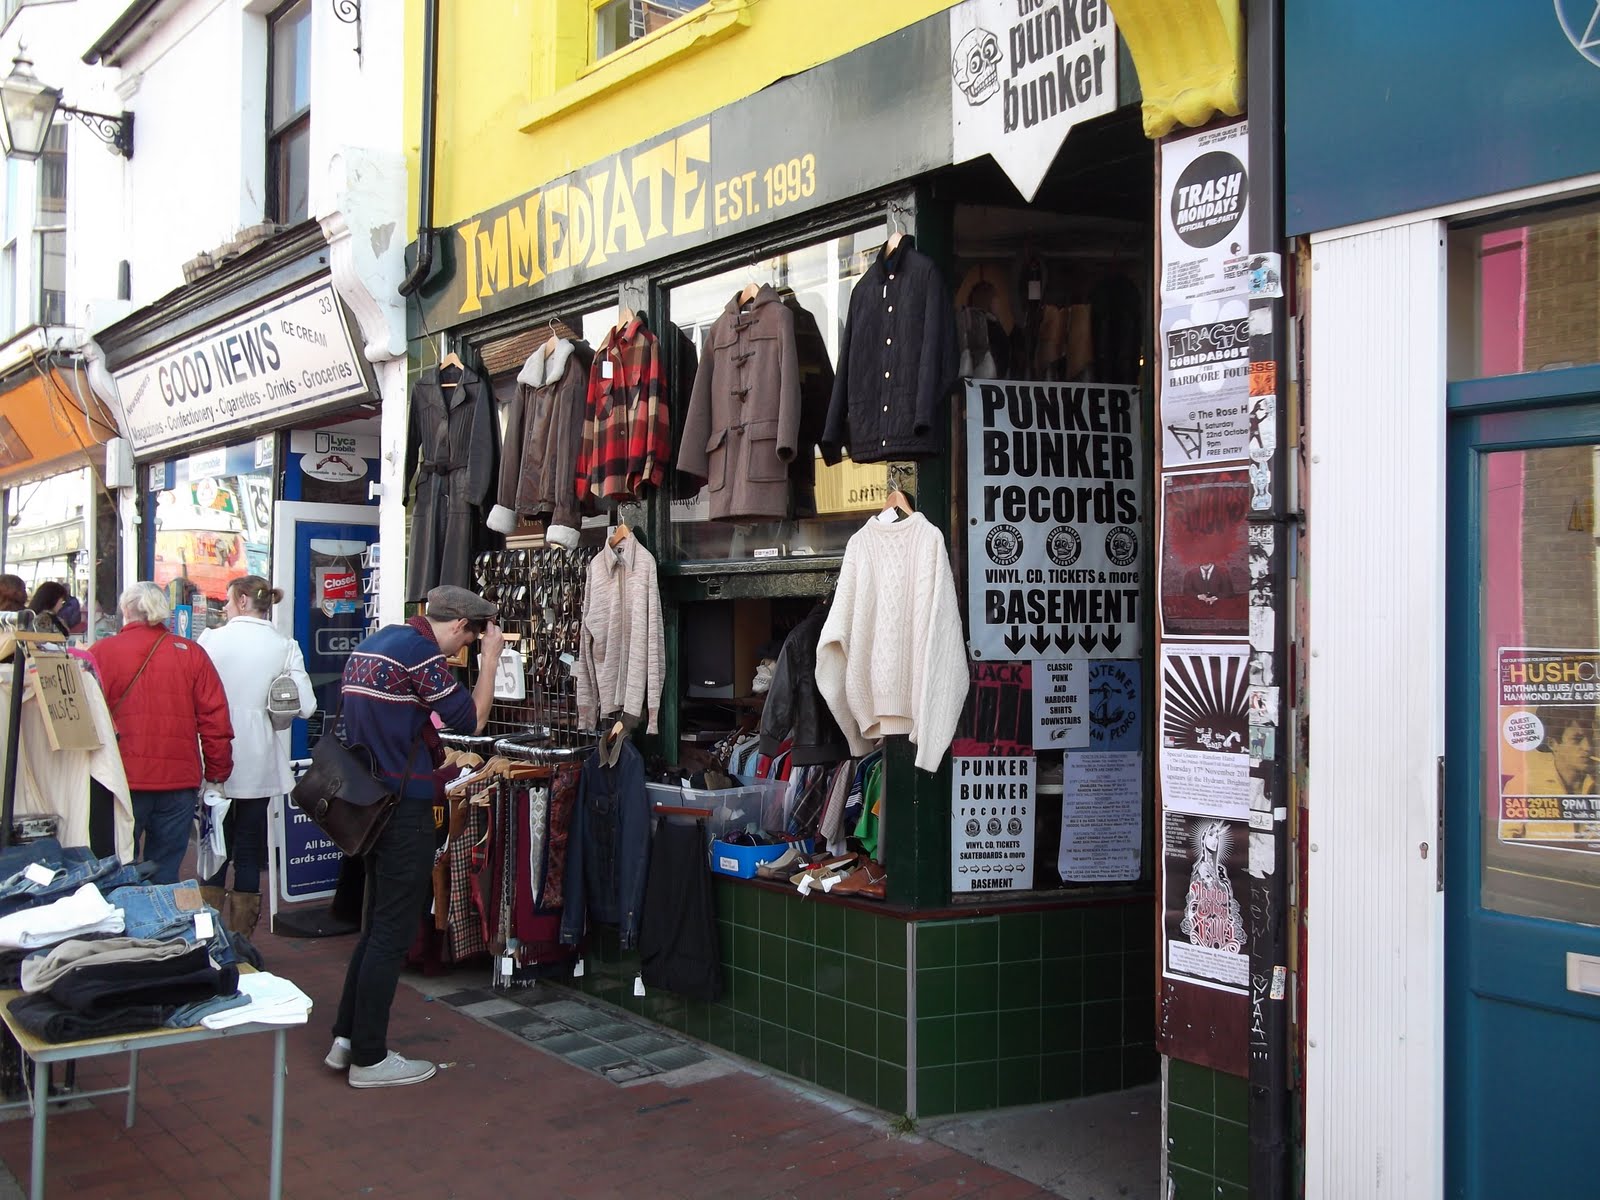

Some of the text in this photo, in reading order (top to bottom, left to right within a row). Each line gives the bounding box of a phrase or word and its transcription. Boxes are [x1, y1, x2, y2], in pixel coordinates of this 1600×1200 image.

[1003, 45, 1106, 134] bunker
[1178, 172, 1242, 210] TRASH
[1177, 196, 1238, 226] MONDAYS
[458, 124, 816, 314] IMMEDIATE EST. 1993
[318, 296, 333, 316] 33
[281, 319, 328, 348] ICE CREAM
[158, 322, 282, 408] GOOD NEWS
[1170, 370, 1220, 388] HARDCORE
[167, 405, 215, 431] Confectionery
[219, 388, 262, 417] Cigarettes
[266, 376, 297, 402] Drinks
[302, 360, 353, 390] Groceries
[980, 384, 1131, 433] PUNKER
[1198, 410, 1214, 420] The
[1216, 407, 1238, 417] Rose
[1205, 420, 1234, 430] Saturday
[1206, 428, 1249, 439] 22nd Octobe
[331, 435, 356, 446] Lyca
[1206, 440, 1221, 448] 9pm
[983, 430, 1134, 480] BUNKER
[1206, 446, 1242, 456] FREE ENTRY
[984, 481, 1137, 523] records
[324, 575, 356, 589] Closed
[985, 569, 1139, 585] VINYL, CD, TICKETS & more
[985, 589, 1140, 625] BASEMENT
[1046, 663, 1073, 671] CLASSIC
[970, 664, 1023, 683] LACK
[1052, 674, 1069, 682] PUNK
[1503, 684, 1536, 692] RHYTHM
[1045, 695, 1077, 703] HARDCORE
[1503, 692, 1551, 701] HAMMOND
[1552, 692, 1573, 701] JAZZ
[1575, 692, 1581, 700] &
[1050, 706, 1072, 714] SHIRTS
[1041, 717, 1081, 725] DOWNSTAIRS
[1510, 717, 1530, 725] GUEST
[1517, 722, 1536, 731] SCOTT
[1512, 729, 1535, 737] FRASER
[1511, 735, 1540, 744] SIMPSON
[961, 760, 1028, 776] PUNKER
[1167, 764, 1192, 774] Thursday
[1205, 768, 1235, 777] November
[1237, 770, 1248, 778] 201
[960, 783, 1028, 800] BUNKER
[1505, 798, 1527, 808] SAT
[1527, 798, 1558, 808] 29TH
[1562, 799, 1587, 810] 9PM
[961, 805, 1027, 816] records
[1506, 807, 1560, 818] OCTOBER
[305, 840, 318, 850] All
[996, 840, 1020, 848] TICKETS
[290, 851, 343, 865] cards accep
[960, 852, 1002, 860] SKATEBOARDS
[1009, 851, 1026, 859] more
[971, 878, 1014, 889] BASEMENT
